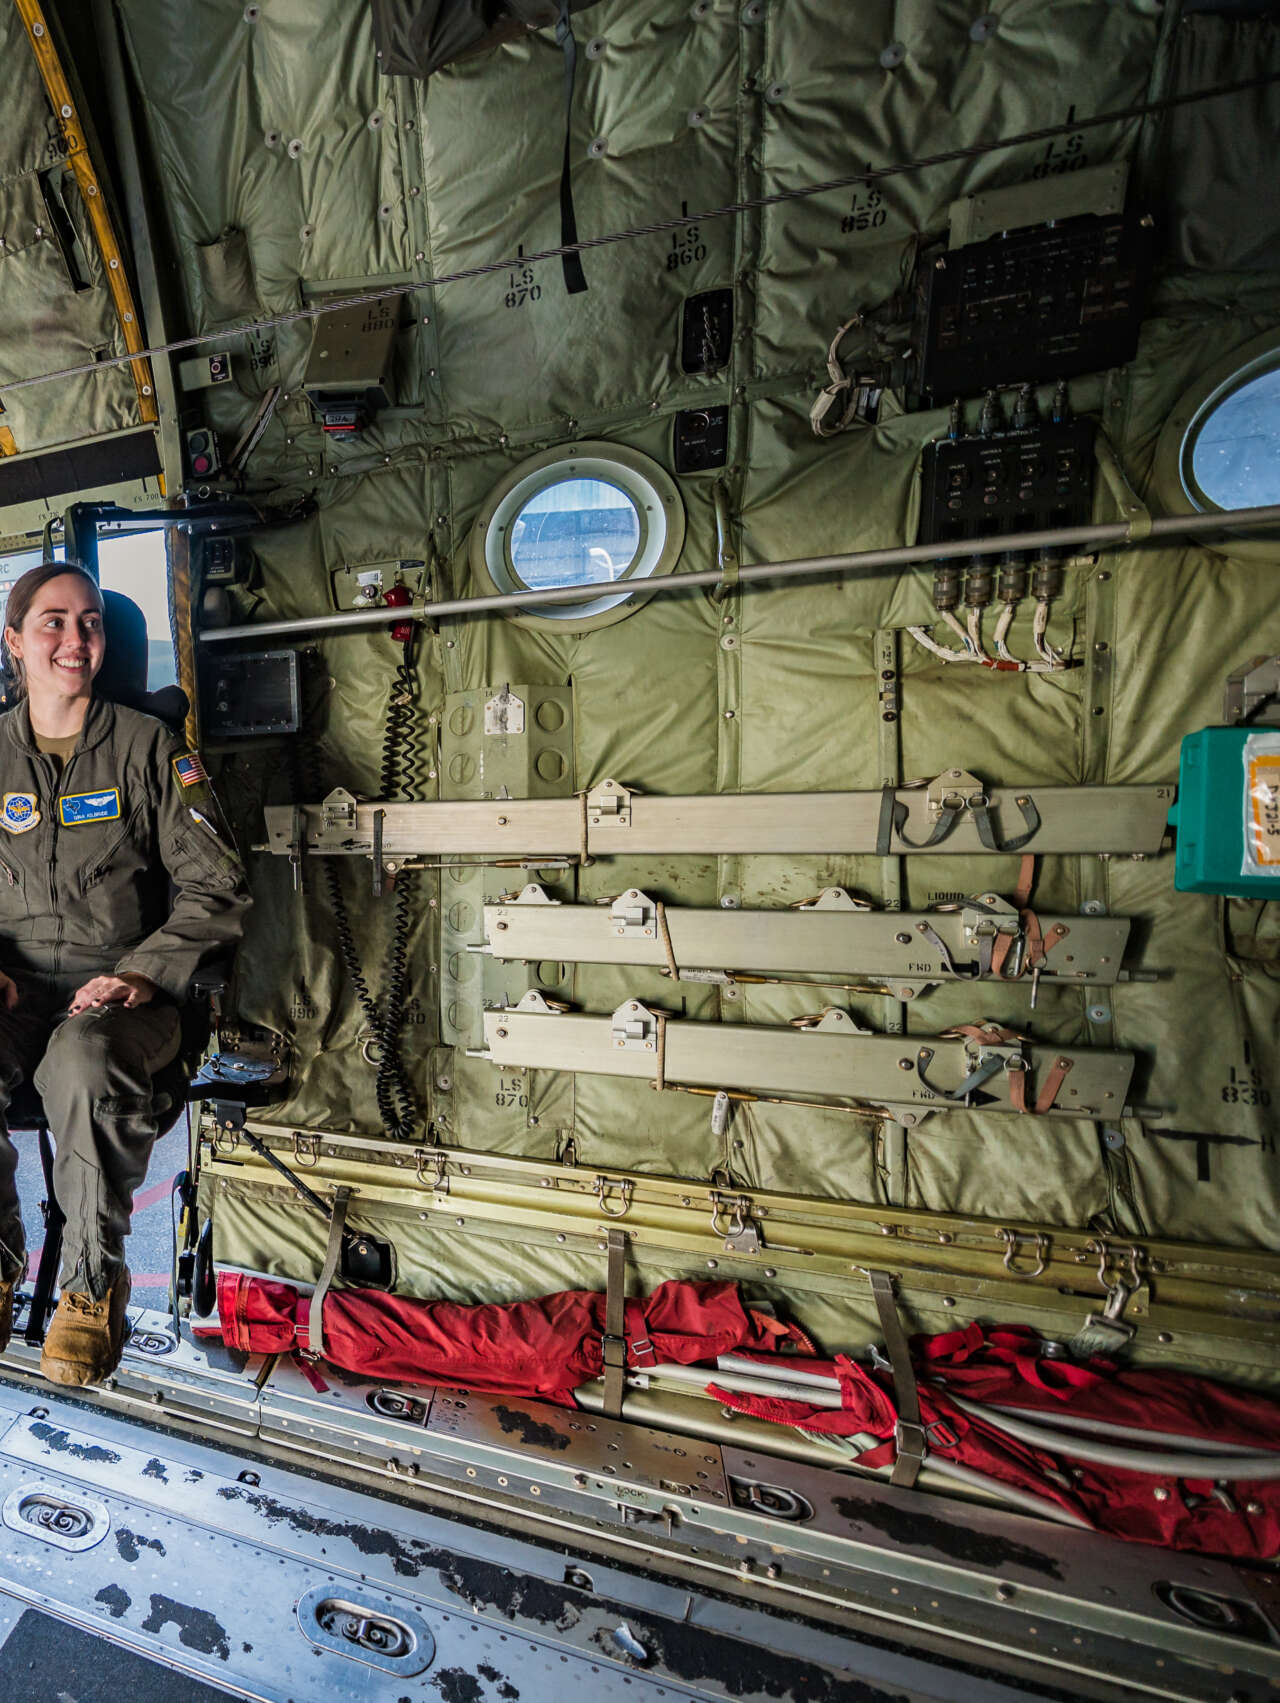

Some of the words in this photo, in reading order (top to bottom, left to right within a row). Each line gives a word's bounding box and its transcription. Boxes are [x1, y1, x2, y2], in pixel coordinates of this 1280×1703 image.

[1046, 134, 1083, 160] LS
[851, 189, 882, 213] LS
[671, 226, 700, 252] LS
[666, 243, 707, 271] 860
[510, 268, 534, 289] LS
[505, 285, 542, 308] 870
[368, 307, 390, 321] LS
[250, 339, 271, 356] LS
[1156, 787, 1170, 799] 21
[927, 891, 965, 902] LIQUID
[908, 962, 932, 973] FWD
[500, 1078, 523, 1092] LS
[1229, 1065, 1263, 1086] LS
[495, 1092, 529, 1108] 870
[1221, 1085, 1272, 1107] 830
